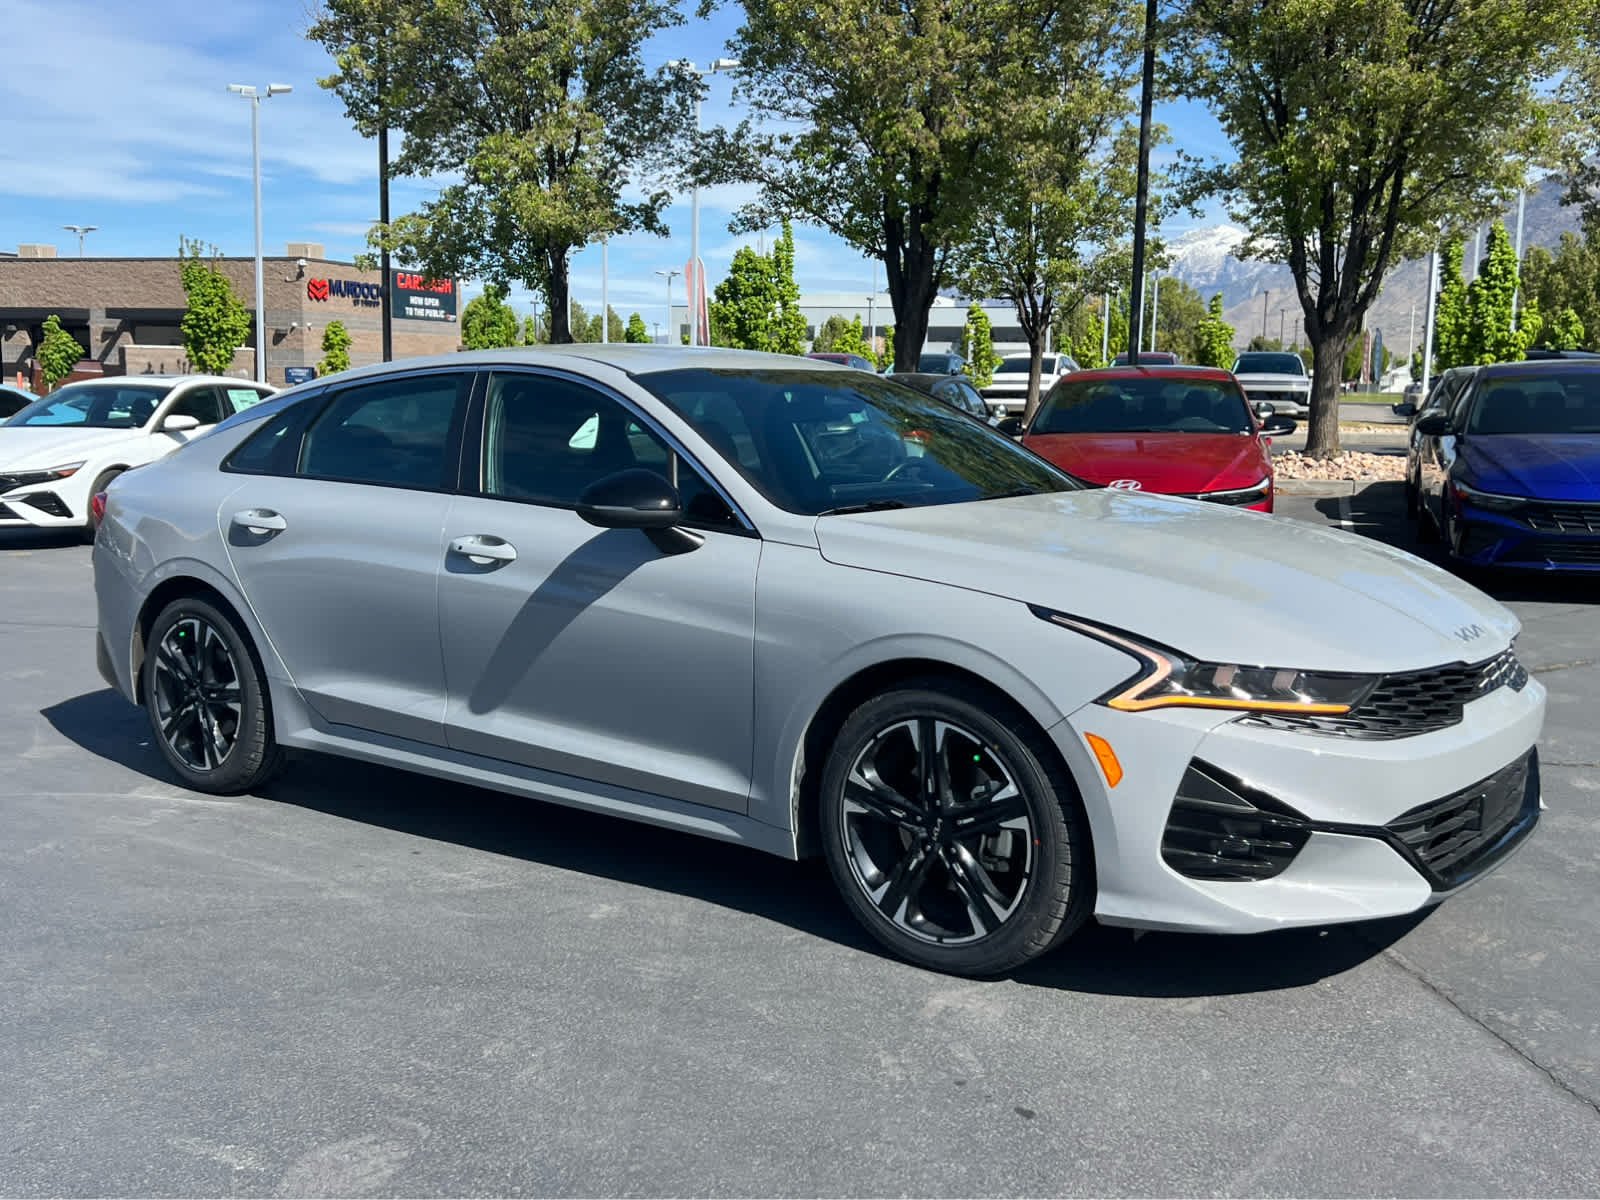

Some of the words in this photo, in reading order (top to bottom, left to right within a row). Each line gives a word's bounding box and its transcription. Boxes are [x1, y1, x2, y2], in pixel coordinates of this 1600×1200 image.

[424, 297, 440, 307] OPEN
[405, 306, 413, 316] TO
[413, 307, 425, 317] THE
[425, 308, 446, 319] PUBLIC
